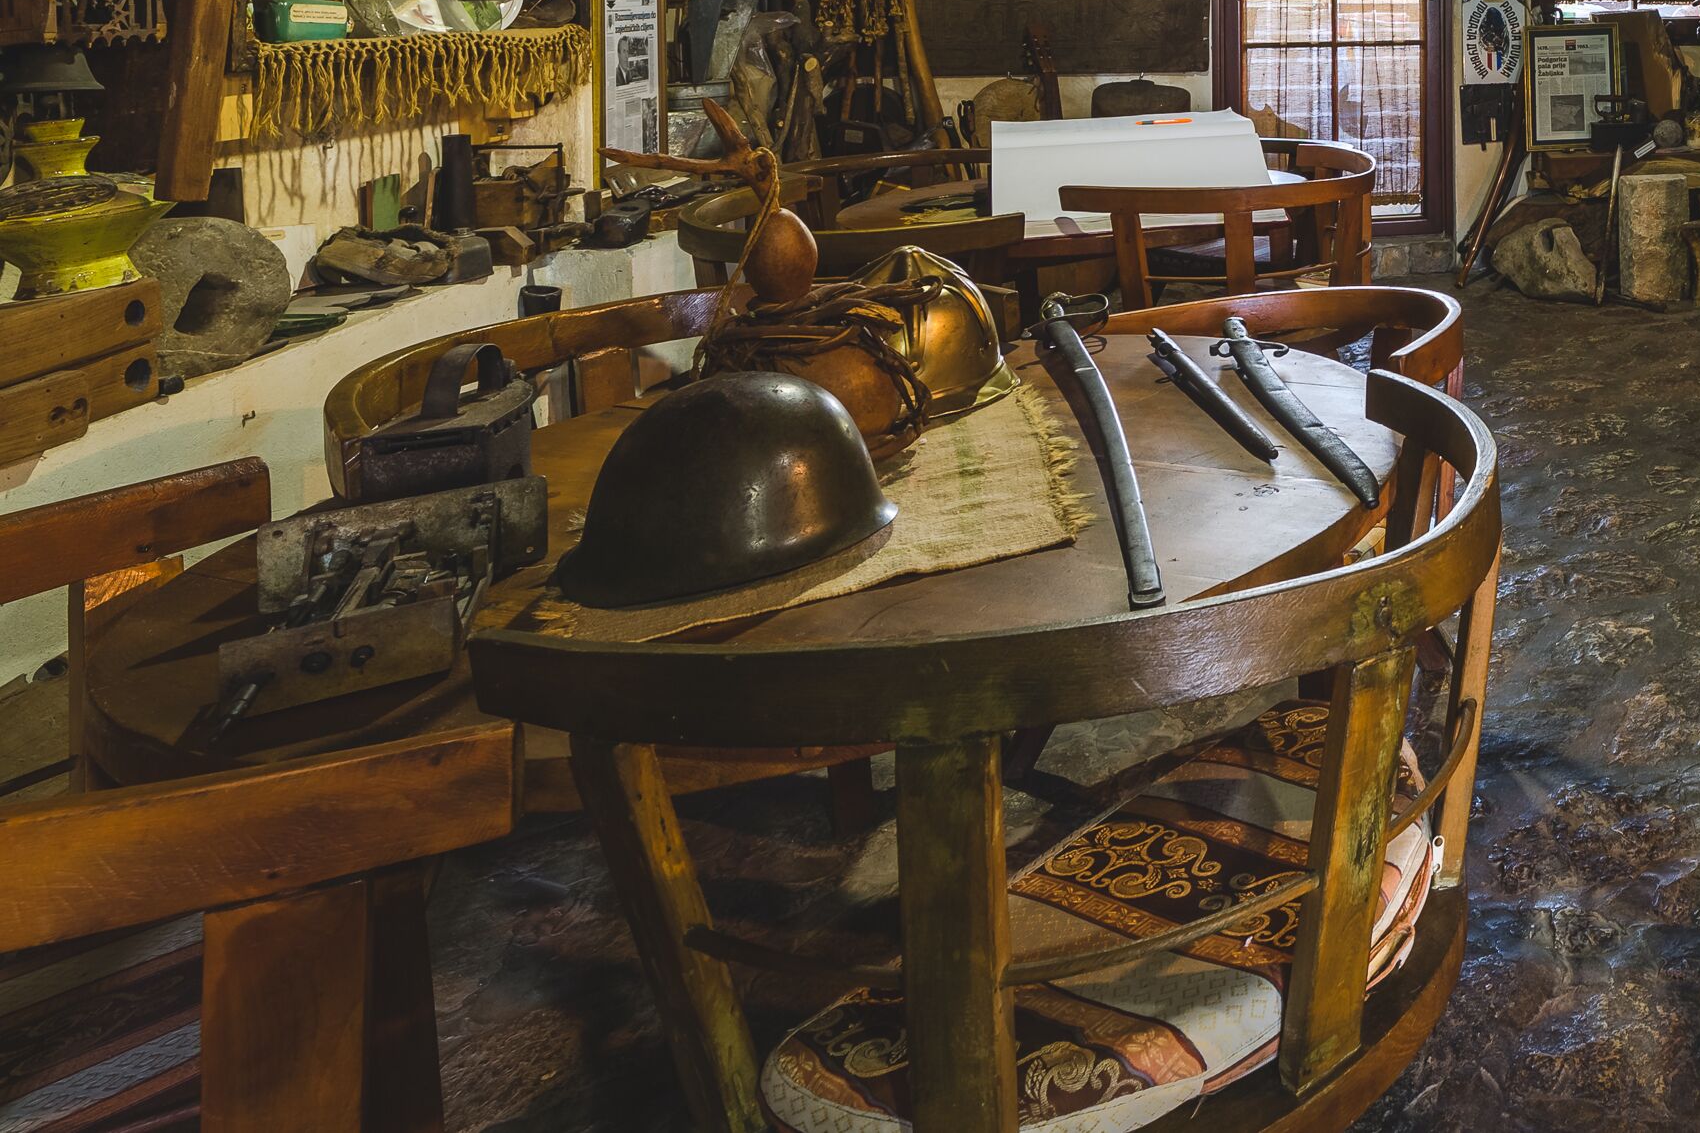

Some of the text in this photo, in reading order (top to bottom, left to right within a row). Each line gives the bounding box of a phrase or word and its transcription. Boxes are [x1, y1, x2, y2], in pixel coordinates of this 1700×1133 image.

[1500, 0, 1522, 78] PRODAJA DUVANA
[1537, 56, 1568, 64] Podgorica
[1552, 62, 1566, 70] prije
[1537, 69, 1564, 77] Žabljaka
